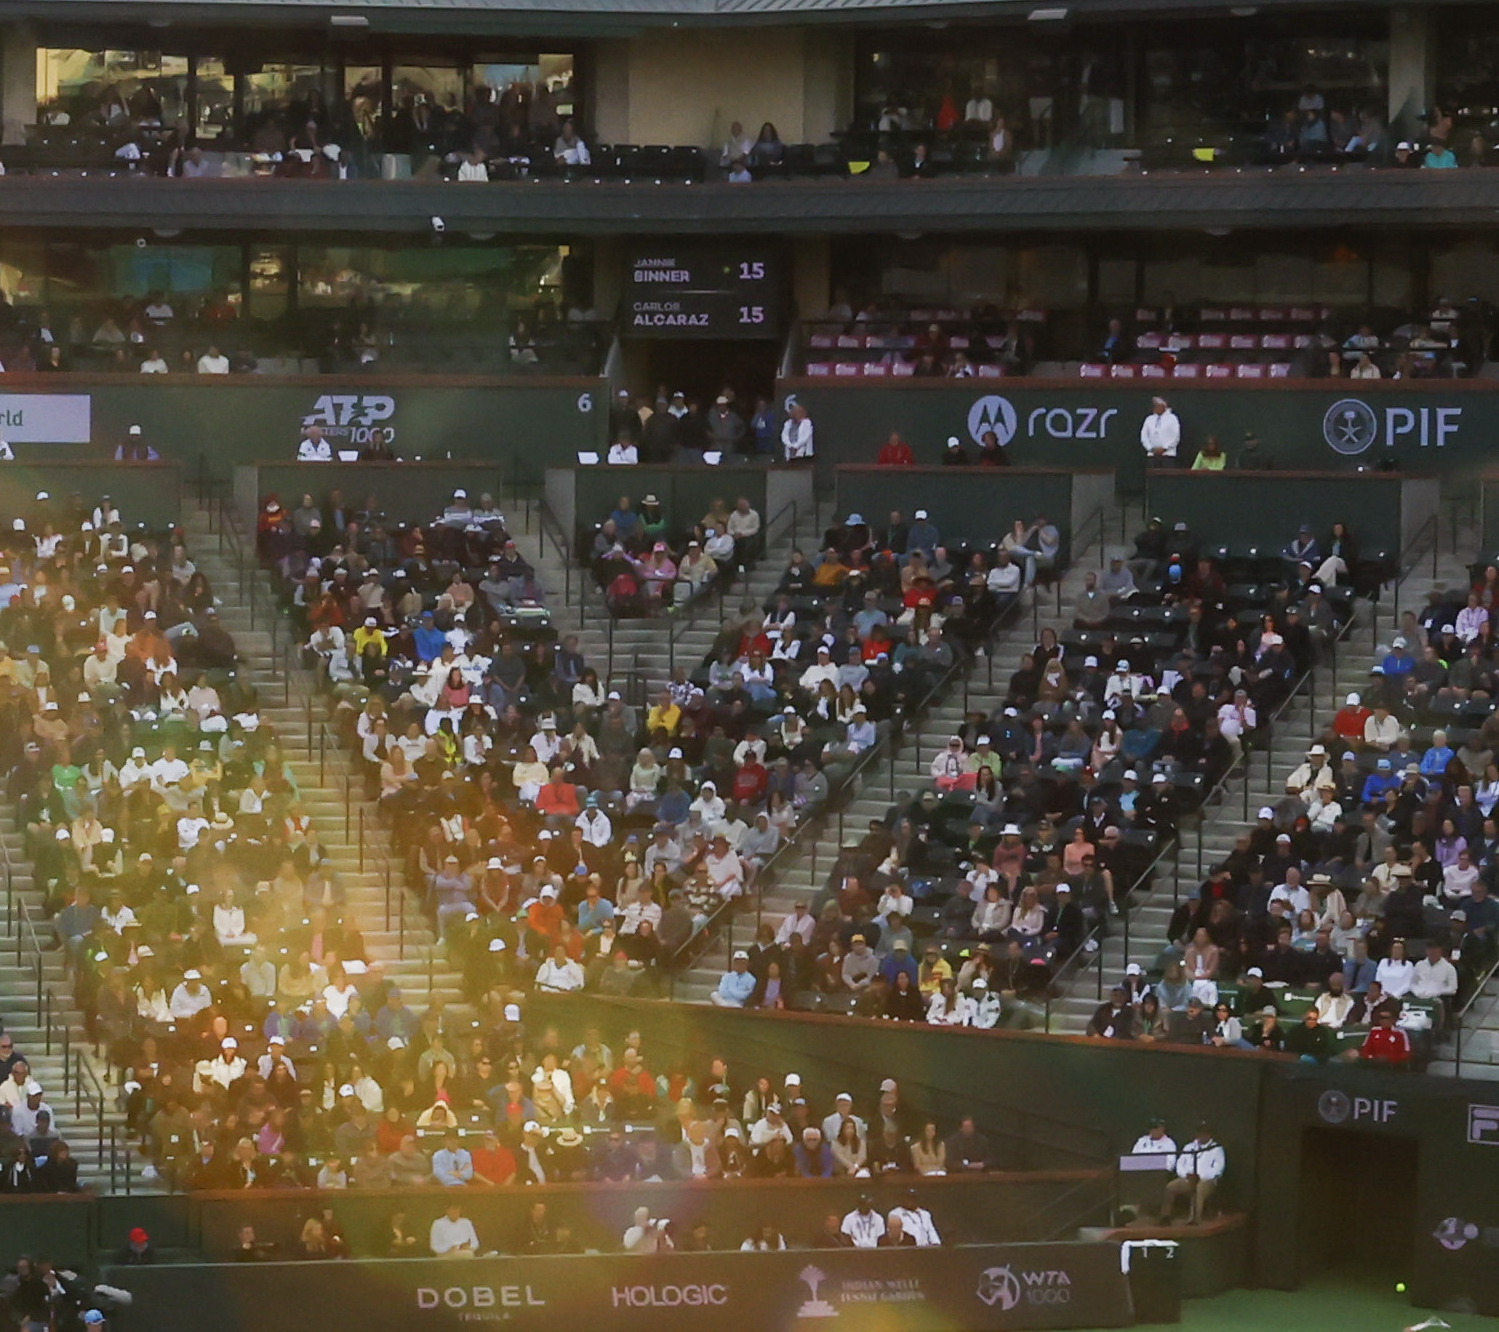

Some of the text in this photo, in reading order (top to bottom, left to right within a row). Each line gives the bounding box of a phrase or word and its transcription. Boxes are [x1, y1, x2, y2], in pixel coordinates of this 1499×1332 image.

[739, 262, 764, 279] 15
[634, 307, 764, 326] ALCARAZ 15
[300, 395, 395, 426] ATP
[577, 393, 592, 413] 6
[1028, 408, 1118, 438] razr
[1385, 407, 1462, 446] PIF
[1353, 1097, 1398, 1123] PIF
[1021, 1270, 1072, 1286] WTA
[415, 1284, 546, 1310] DOBEL
[611, 1285, 727, 1307] HOLOGIC
